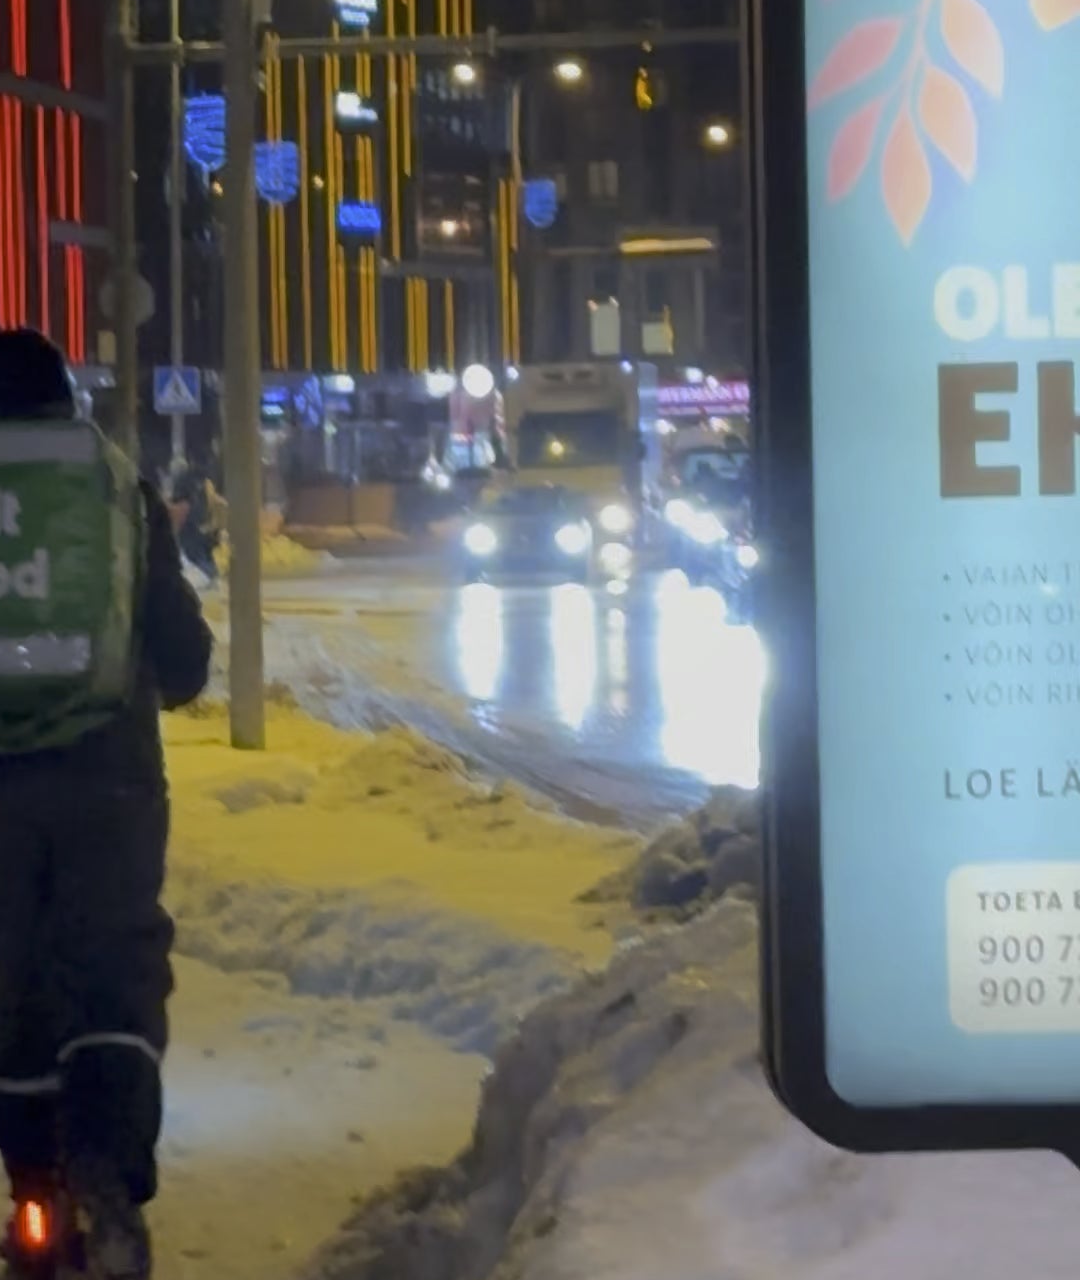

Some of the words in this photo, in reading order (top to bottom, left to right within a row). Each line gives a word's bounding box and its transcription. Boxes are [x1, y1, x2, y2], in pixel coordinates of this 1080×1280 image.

[945, 768, 1017, 800] LOE
[977, 890, 1063, 912] TOETA
[978, 934, 1045, 964] 900
[979, 977, 1047, 1007] 900
